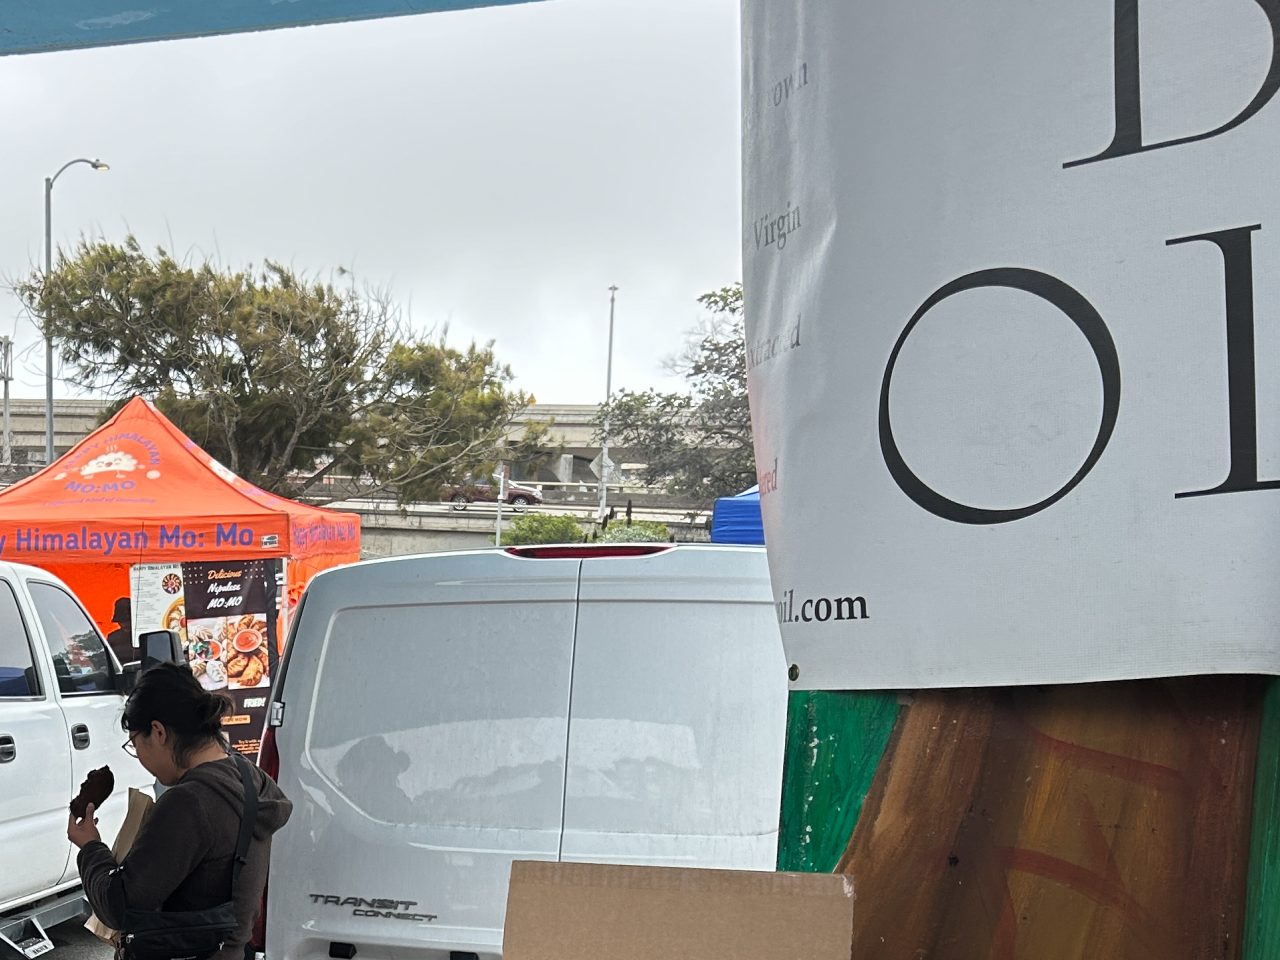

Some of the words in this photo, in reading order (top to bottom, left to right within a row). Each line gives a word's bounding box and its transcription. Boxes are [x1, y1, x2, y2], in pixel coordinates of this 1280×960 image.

[754, 200, 801, 251] Virgin
[17, 526, 148, 556] Himalayan
[160, 525, 205, 548] Mo:
[216, 523, 254, 547] Mo
[207, 570, 242, 580] Delicious
[309, 894, 418, 910] TRANSIT
[353, 909, 437, 922] CONNECT
